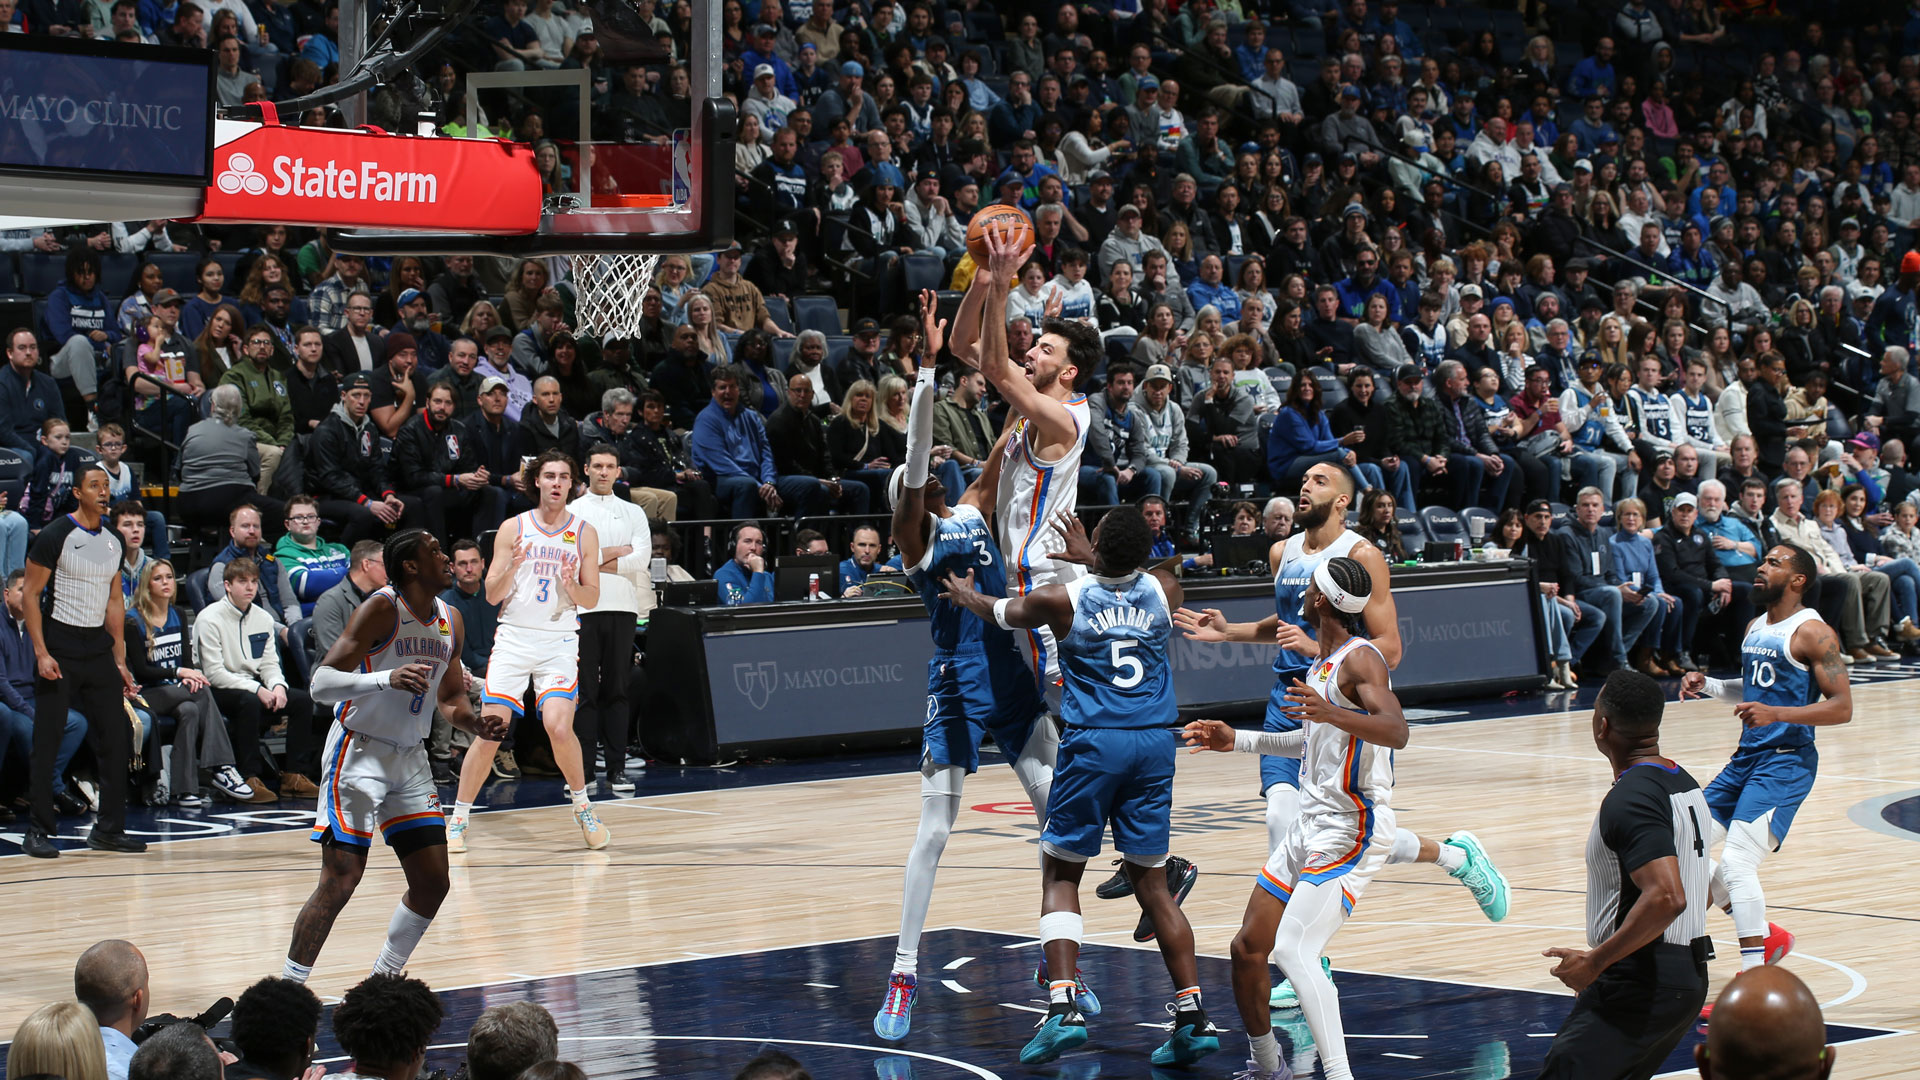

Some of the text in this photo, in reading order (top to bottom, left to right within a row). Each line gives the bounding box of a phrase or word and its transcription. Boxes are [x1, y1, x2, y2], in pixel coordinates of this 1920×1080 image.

[0, 95, 182, 131] MAYO CLINIC
[973, 540, 993, 566] 3
[533, 561, 560, 577] CITY
[536, 577, 551, 604] 3
[1087, 606, 1155, 636] EDWARDS
[1418, 619, 1512, 642] MAYO CLINIC
[784, 664, 904, 690] MAYO CLINIC
[1110, 639, 1144, 688] 5
[1751, 660, 1777, 688] 10
[408, 688, 427, 716] 8
[1688, 805, 1704, 858] 4
